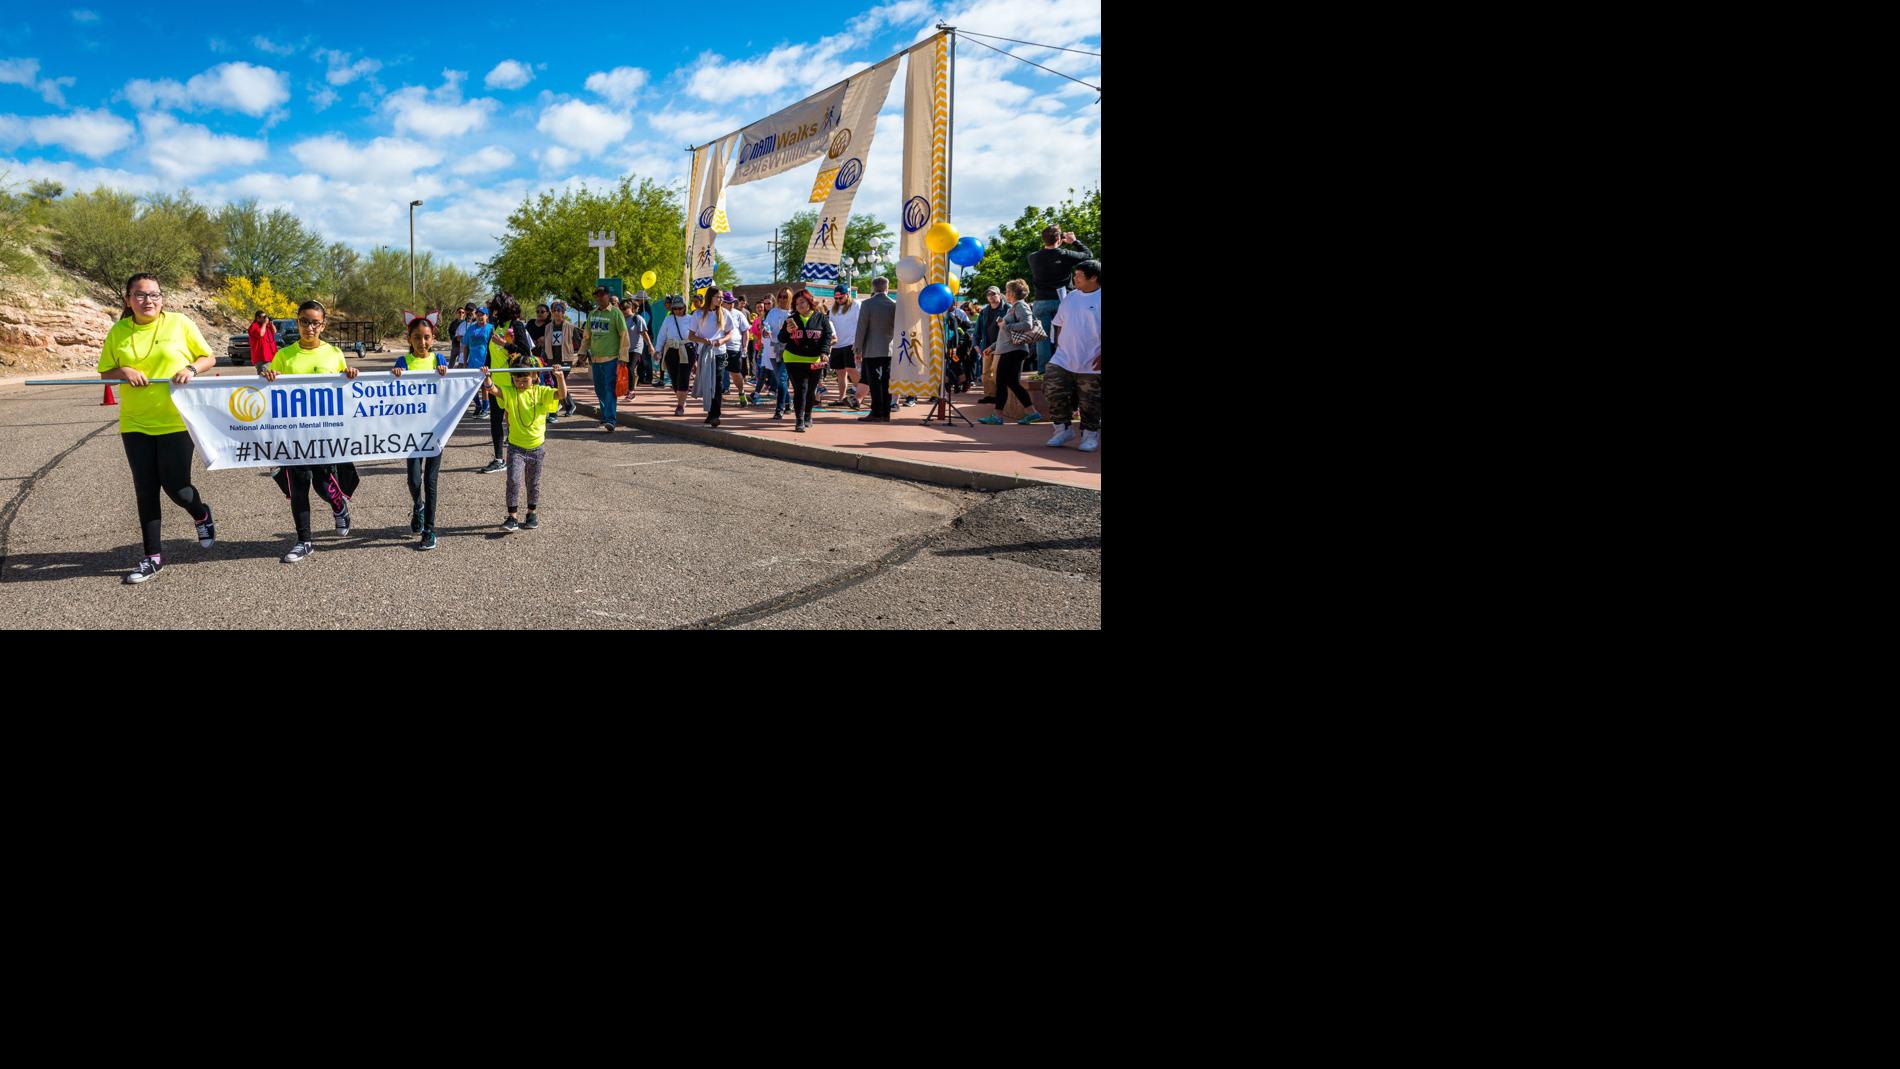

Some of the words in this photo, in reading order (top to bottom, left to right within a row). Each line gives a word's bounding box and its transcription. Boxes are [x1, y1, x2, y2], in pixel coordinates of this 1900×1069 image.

[352, 380, 438, 399] Southern
[271, 387, 344, 419] NAMI
[353, 400, 427, 418] Arizona
[259, 423, 287, 431] Alliance
[299, 421, 321, 430] Mental
[235, 431, 435, 462] #NAMIWalkSAZ
